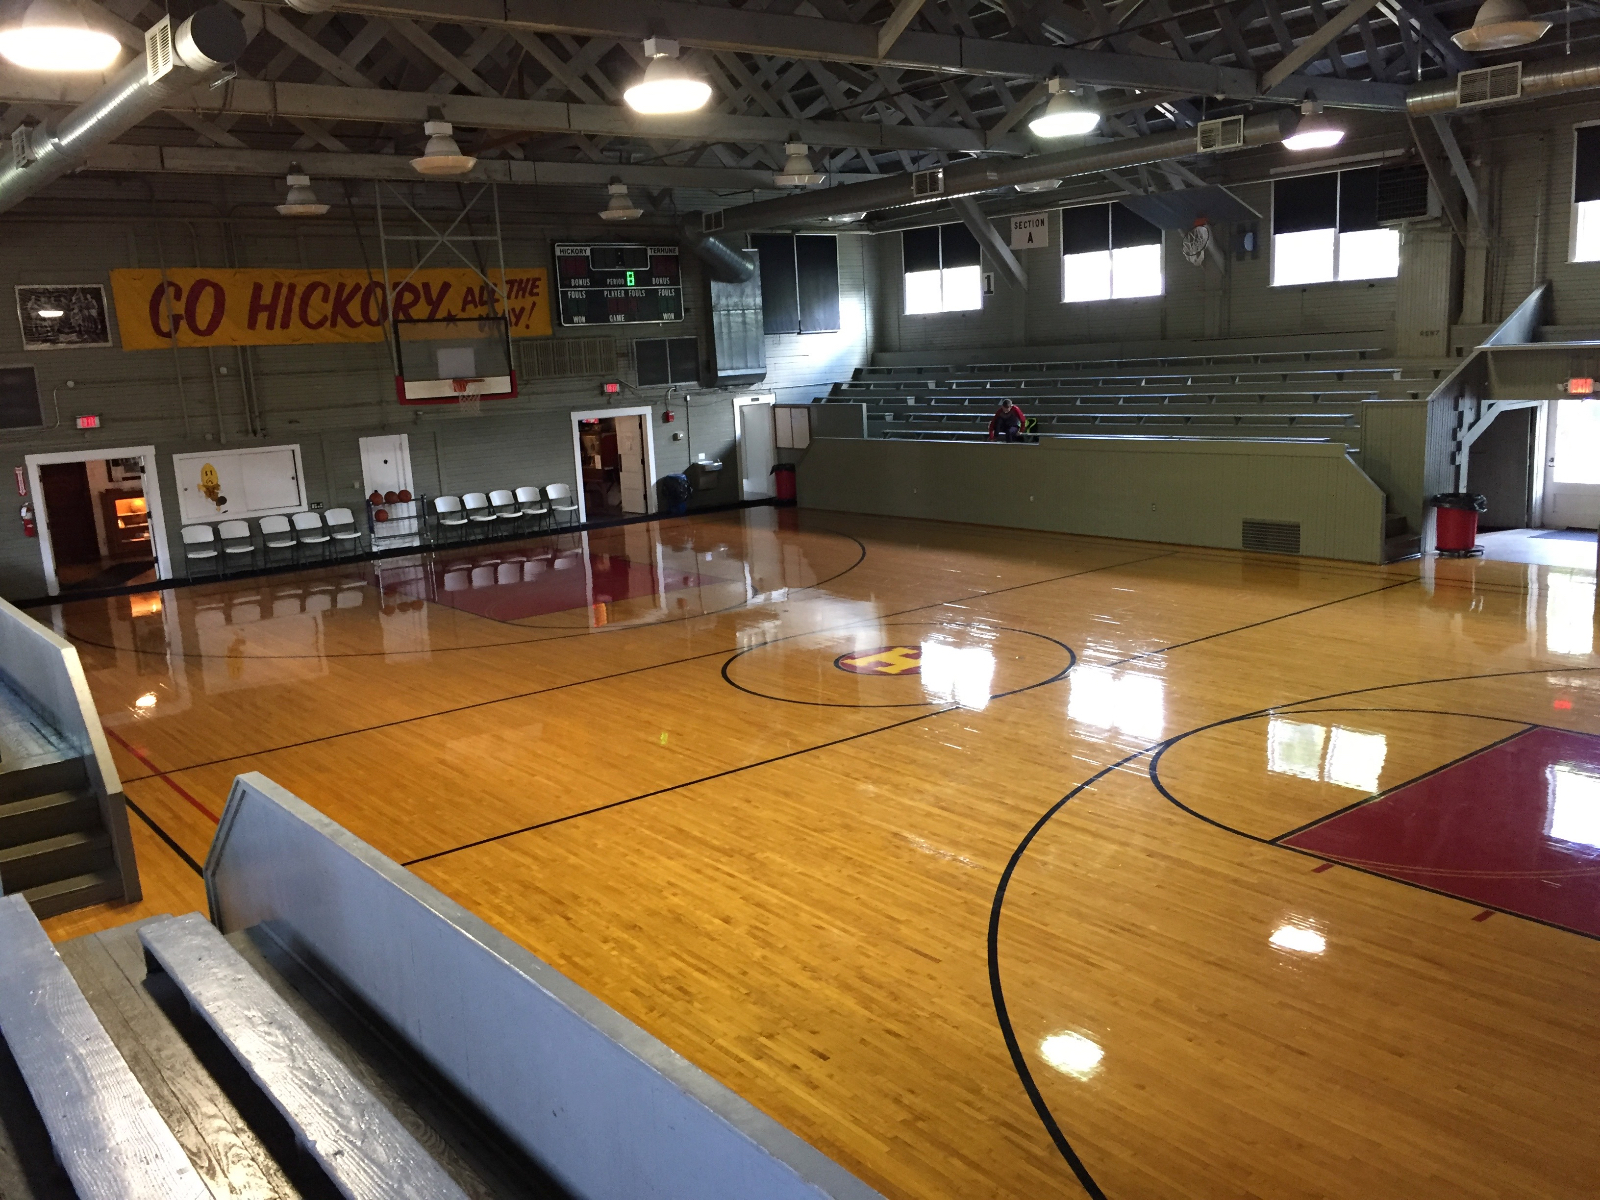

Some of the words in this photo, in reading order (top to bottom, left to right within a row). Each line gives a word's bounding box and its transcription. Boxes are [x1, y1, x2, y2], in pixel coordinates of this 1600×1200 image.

[1014, 218, 1045, 230] SECTION
[1027, 231, 1034, 244] A
[649, 247, 677, 255] TERHUNE
[570, 278, 591, 287] BONUS
[984, 274, 994, 295] 1
[461, 282, 501, 312] ALL
[505, 277, 542, 300] THE
[567, 291, 587, 299] FOULS
[604, 290, 626, 298] PLAYER
[628, 289, 646, 297] FOULS
[658, 289, 676, 297] FOULS
[149, 278, 226, 338] GO
[247, 281, 452, 332] HICKORY
[572, 315, 586, 324] WON
[609, 314, 626, 323] GAME
[662, 312, 675, 320] WON
